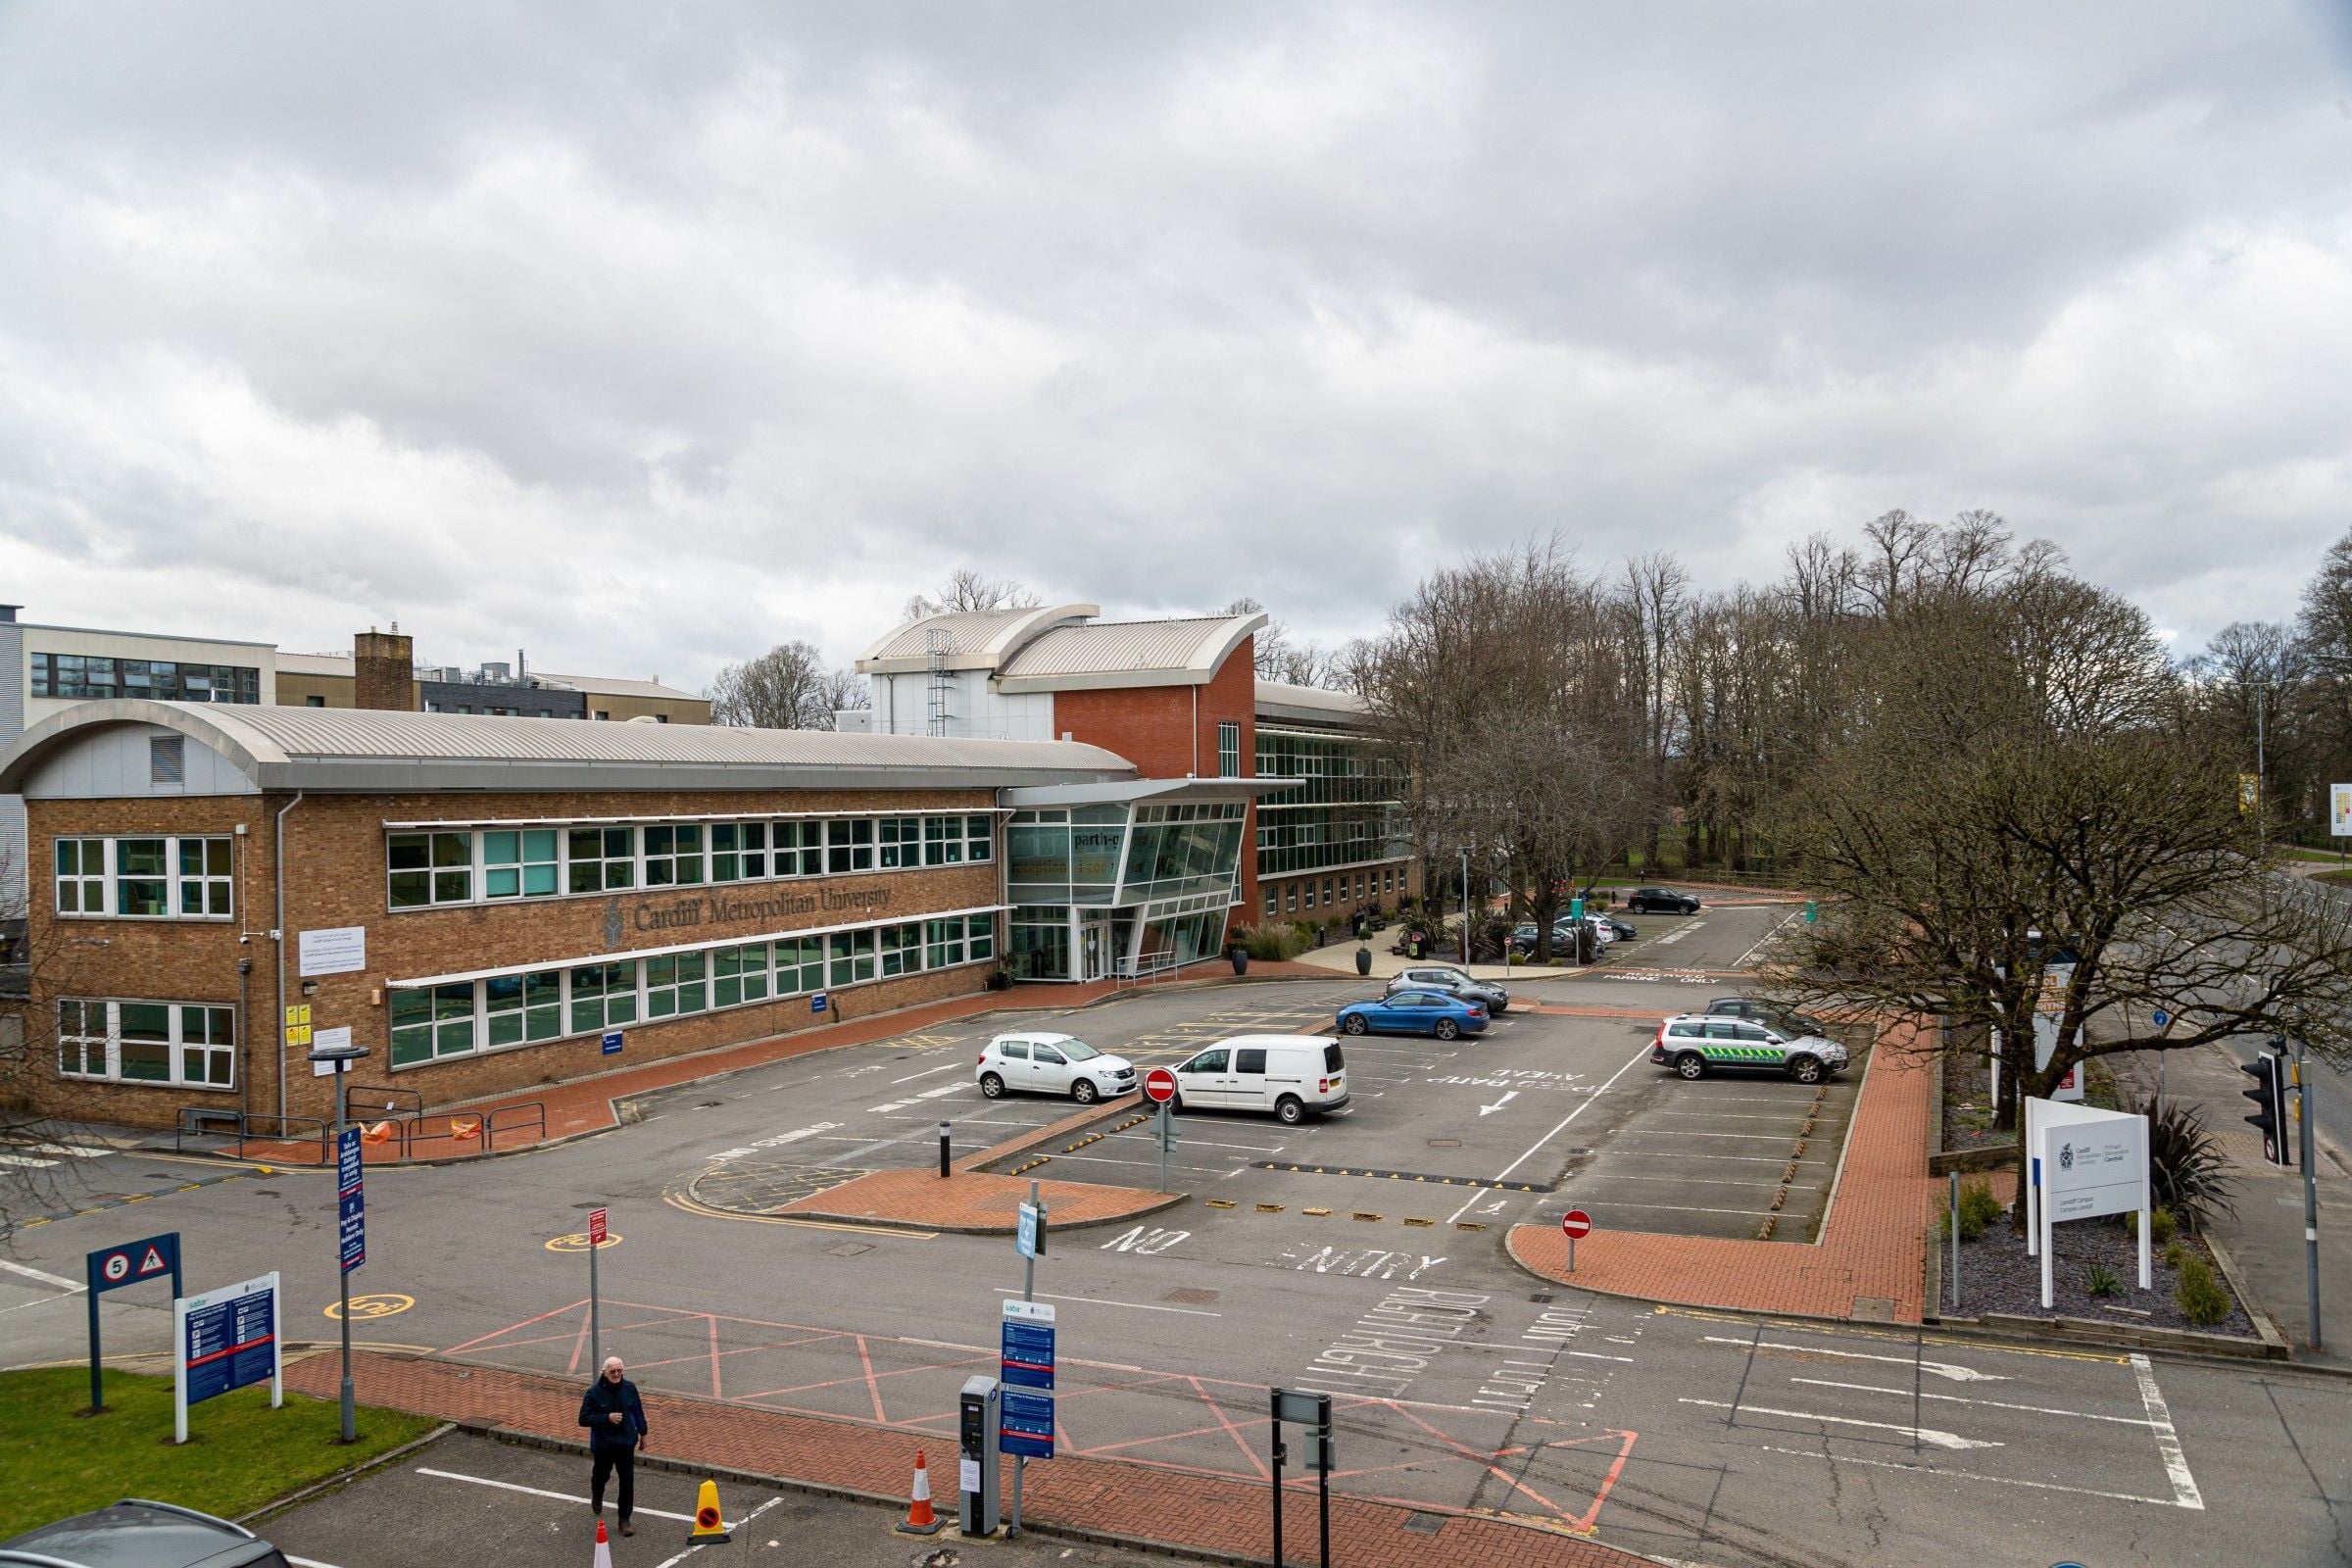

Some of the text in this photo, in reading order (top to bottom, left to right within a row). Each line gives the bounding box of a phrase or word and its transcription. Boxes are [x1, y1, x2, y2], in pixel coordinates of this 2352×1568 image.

[634, 887, 891, 931] Cardiff Metropolitan University
[1707, 1054, 1784, 1063] AMBULANCE
[1426, 1075, 1511, 1087] RAMP
[1491, 1069, 1586, 1081] AHEAD
[351, 1211, 364, 1221] Display
[346, 1222, 359, 1234] Permit
[355, 1228, 364, 1237] Only
[1100, 1225, 1192, 1254] NO
[112, 1259, 122, 1274] 5
[188, 1299, 206, 1309] saba
[1005, 1304, 1020, 1313] saba
[1352, 1287, 1491, 1336] RIGHT
[1295, 1334, 1445, 1397] RIGHT
